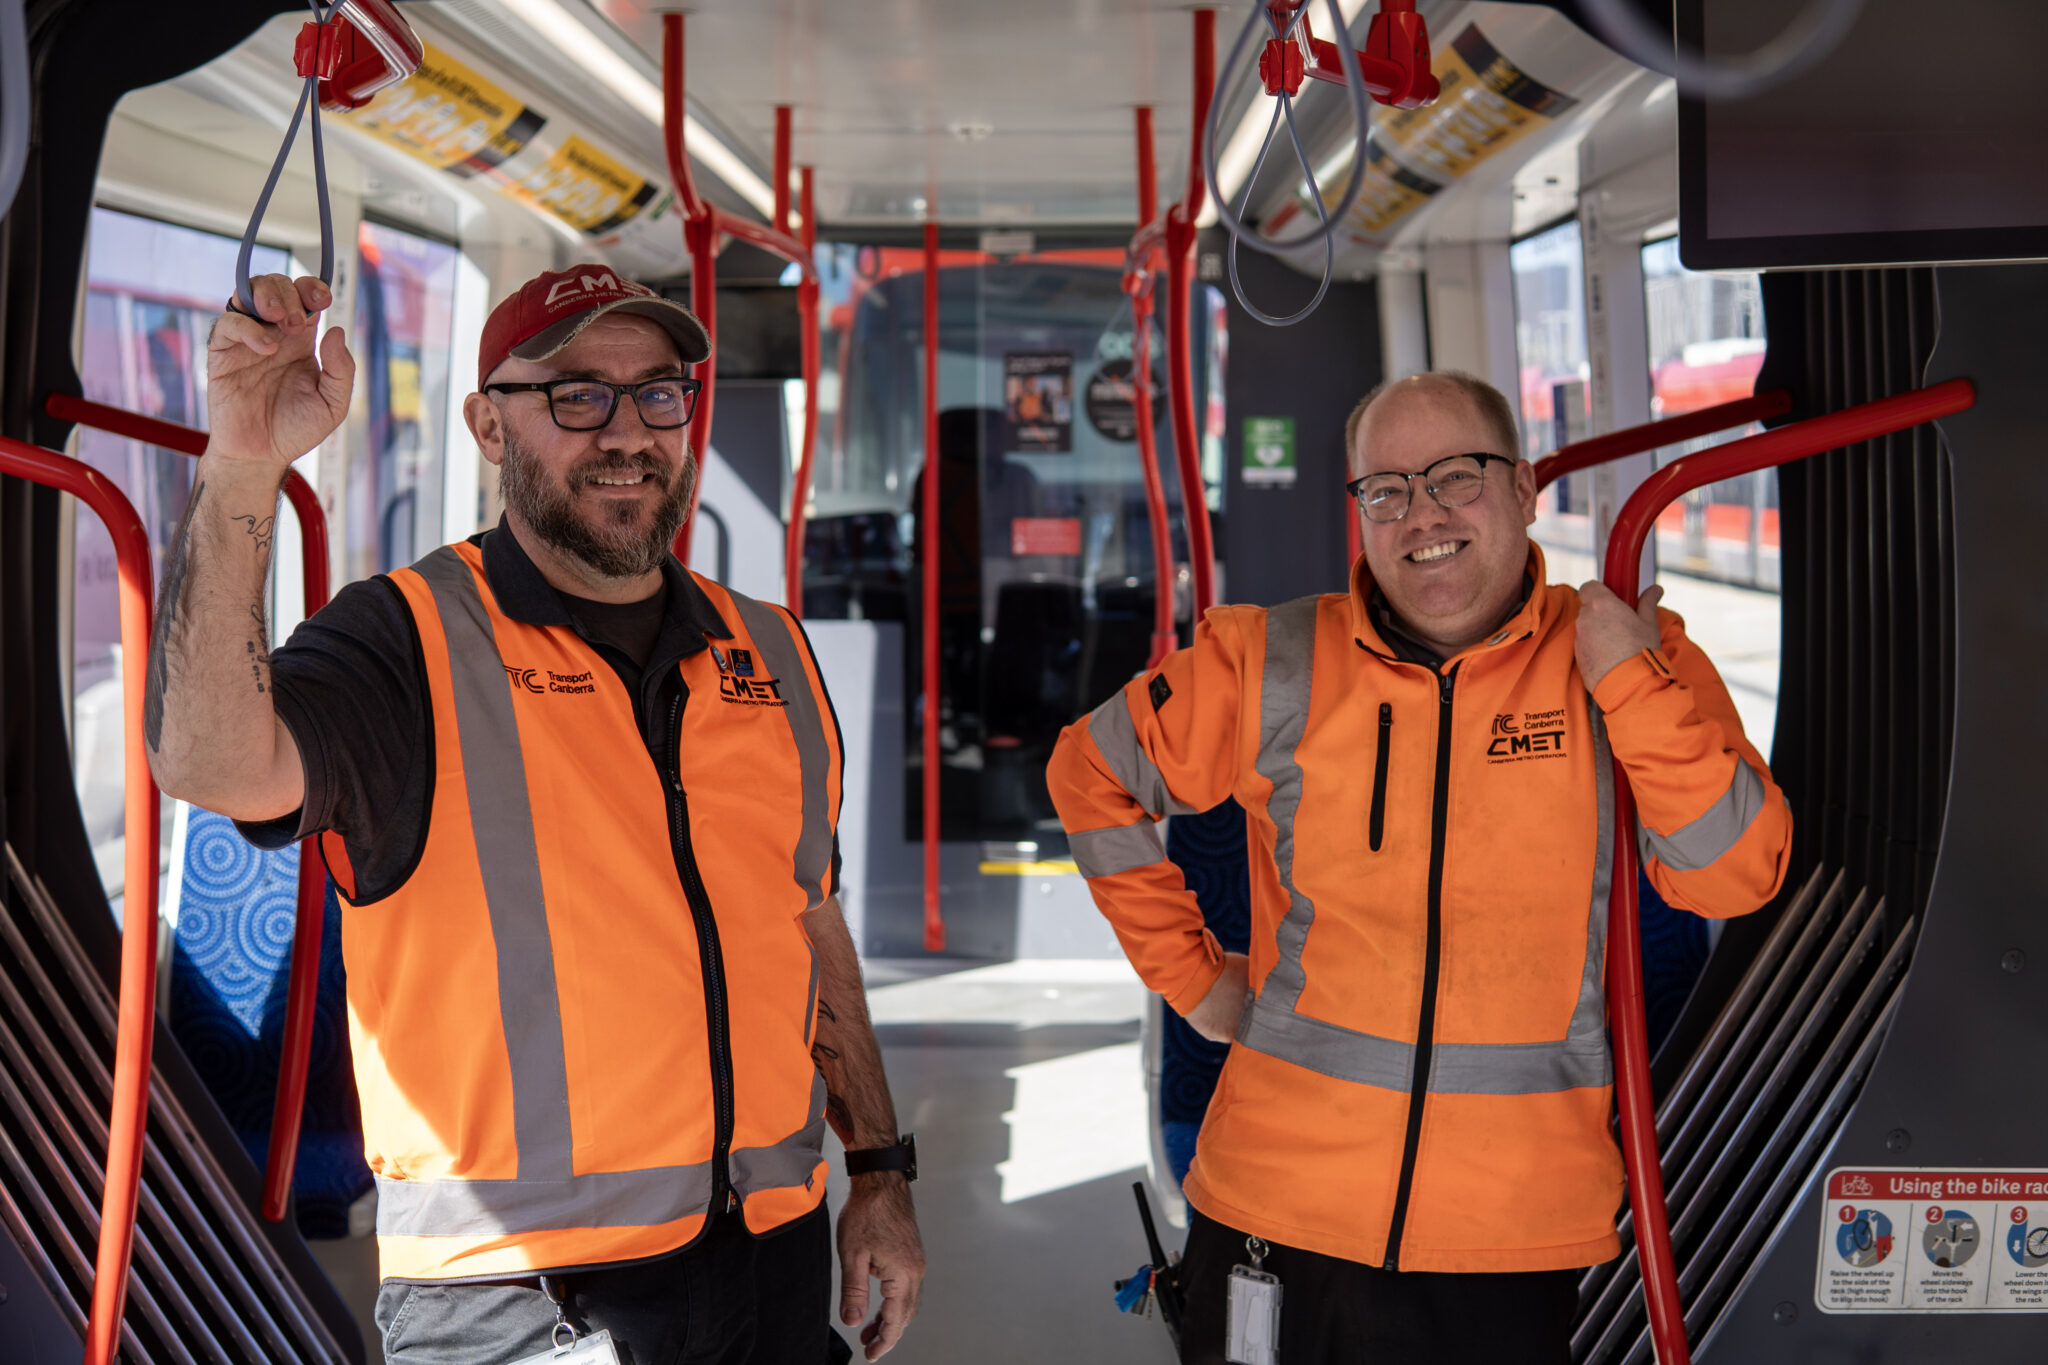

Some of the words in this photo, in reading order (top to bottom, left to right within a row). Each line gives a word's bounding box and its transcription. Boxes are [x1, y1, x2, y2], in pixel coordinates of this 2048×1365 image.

[548, 293, 594, 313] CANBERRA
[547, 670, 593, 684] Transport
[549, 682, 596, 694] Canberra
[720, 674, 781, 699] CMET
[1524, 709, 1565, 720] Transport
[1524, 719, 1564, 729] Canberra
[1487, 731, 1565, 756] CMET
[1890, 1177, 1943, 1199] Using
[1947, 1178, 1978, 1194] the
[1981, 1178, 2021, 1195] bike
[1844, 1207, 1851, 1219] 1
[1930, 1208, 1939, 1221] 2
[2014, 1208, 2024, 1221] 3
[1942, 1279, 1973, 1287] sideways
[2022, 1288, 2042, 1296] wings
